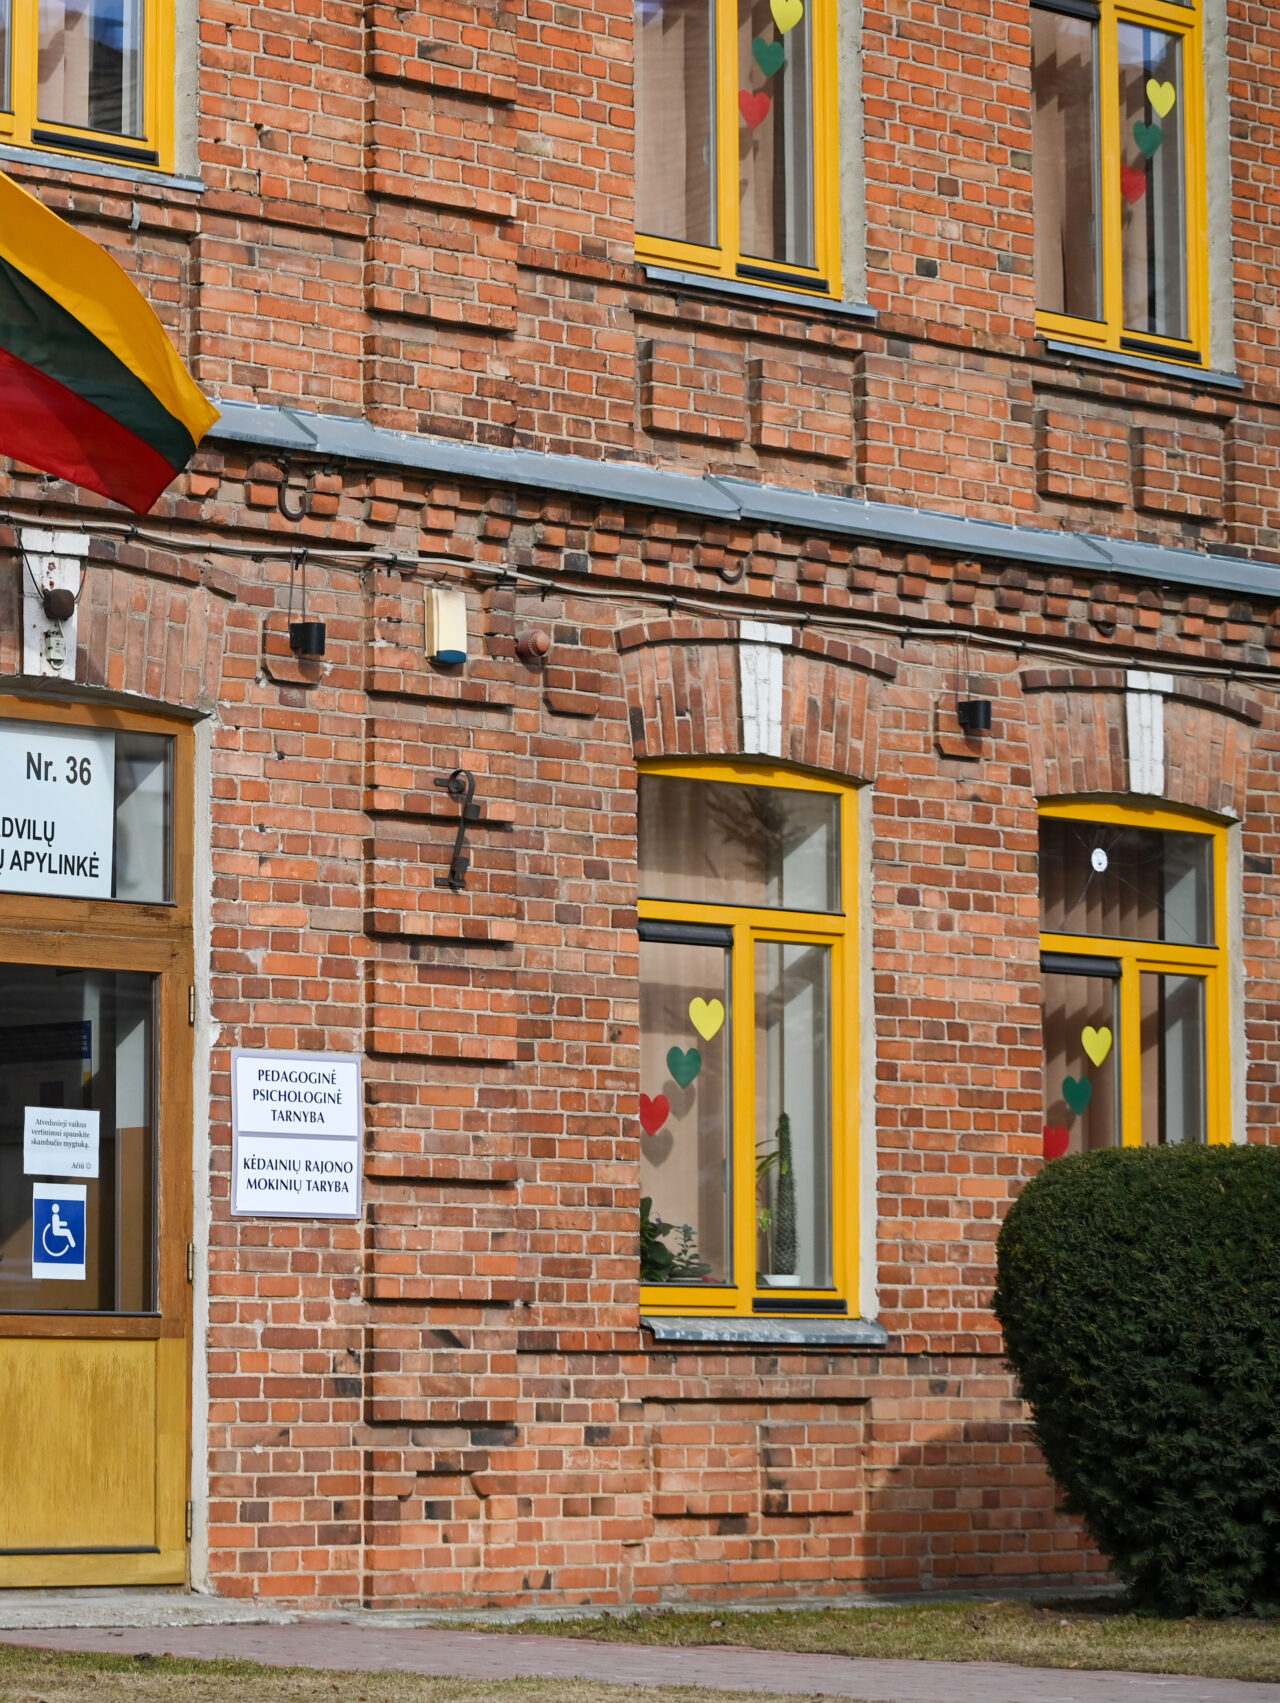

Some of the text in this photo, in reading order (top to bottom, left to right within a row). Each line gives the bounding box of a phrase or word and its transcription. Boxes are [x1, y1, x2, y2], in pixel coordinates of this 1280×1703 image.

[26, 751, 92, 786] Nr. 36
[9, 850, 100, 878] APYLINKĖ
[258, 1069, 337, 1085] PEDAGOGINĖ
[253, 1088, 342, 1105] PSICHOLOGINĖ
[35, 1118, 87, 1129] Atvedusieji vaikus
[271, 1109, 325, 1124] TARNYBA
[31, 1128, 90, 1139] vertinimui spauskite
[31, 1137, 62, 1147] skambučio
[243, 1154, 354, 1175] KĖDAINIŲ RAJONO
[246, 1178, 349, 1194] MOKINIŲ TARYBA
